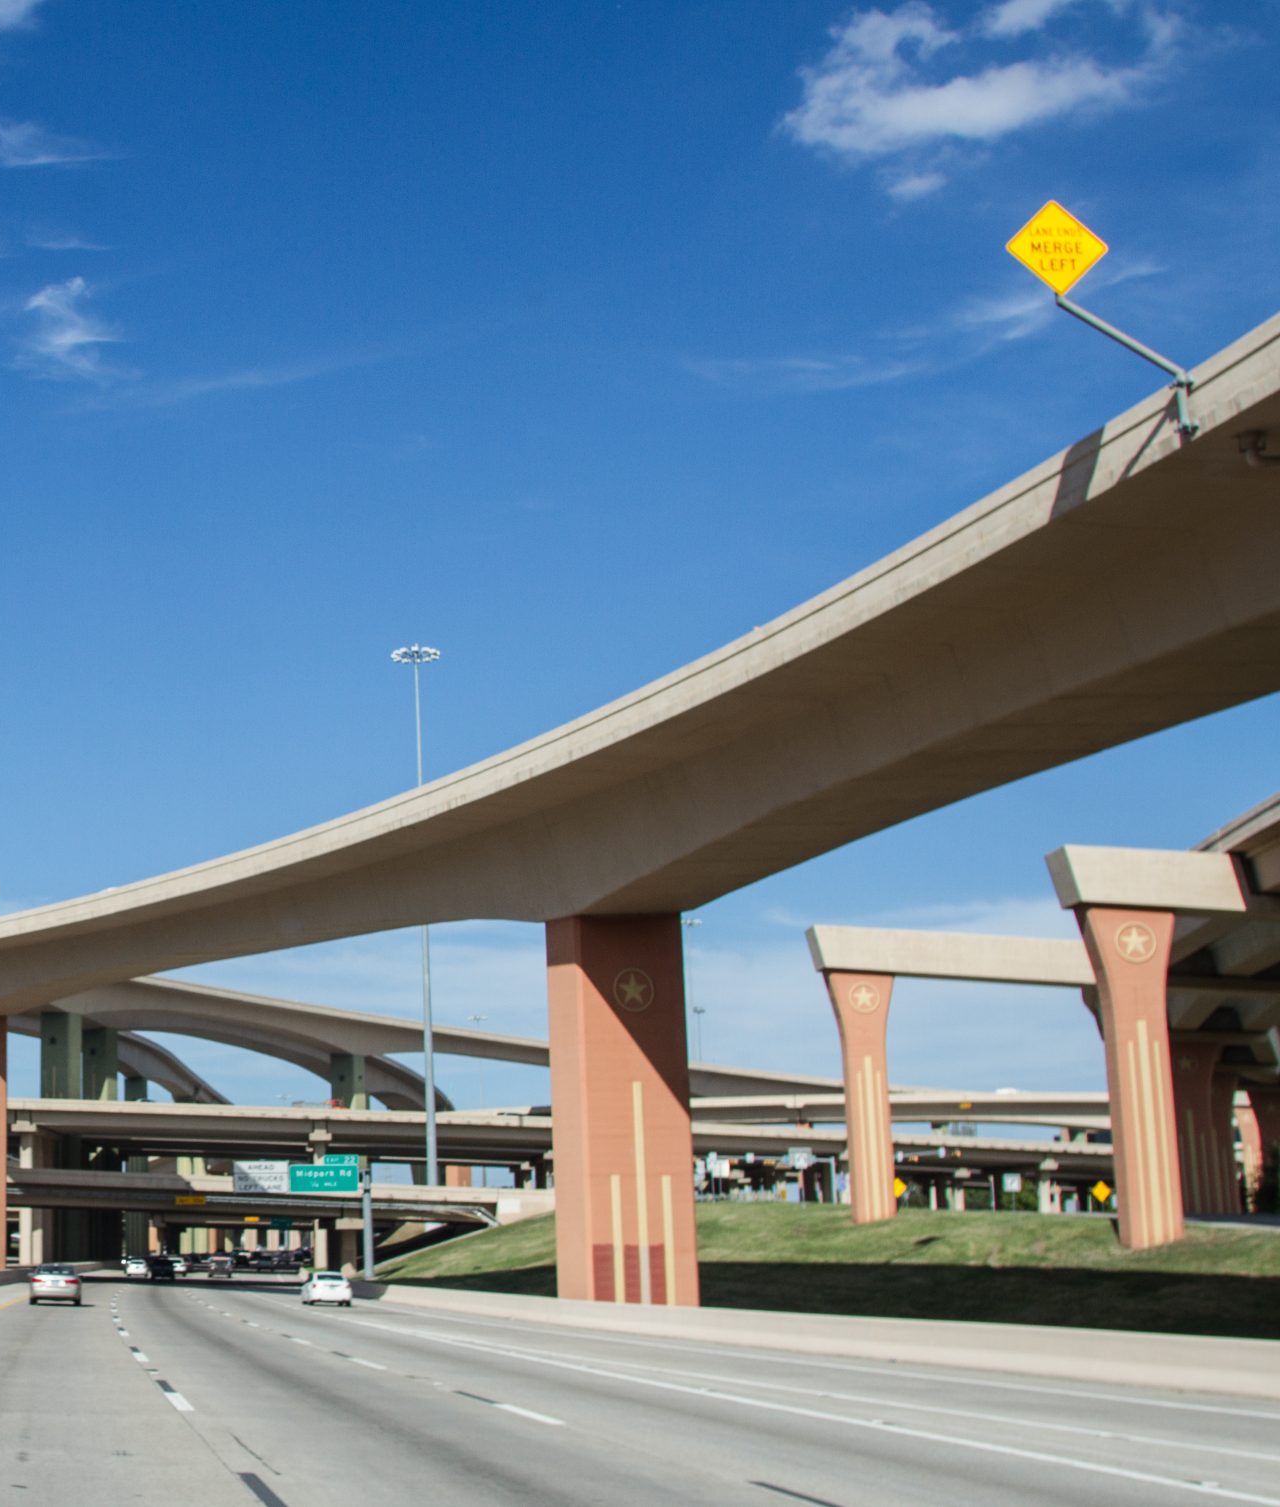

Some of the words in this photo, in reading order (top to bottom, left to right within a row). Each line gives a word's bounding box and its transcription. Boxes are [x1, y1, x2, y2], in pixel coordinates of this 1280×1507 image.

[1030, 241, 1083, 254] MERGE
[1040, 258, 1076, 271] LEFT
[344, 1155, 356, 1164] 22
[340, 1169, 352, 1177] Rd
